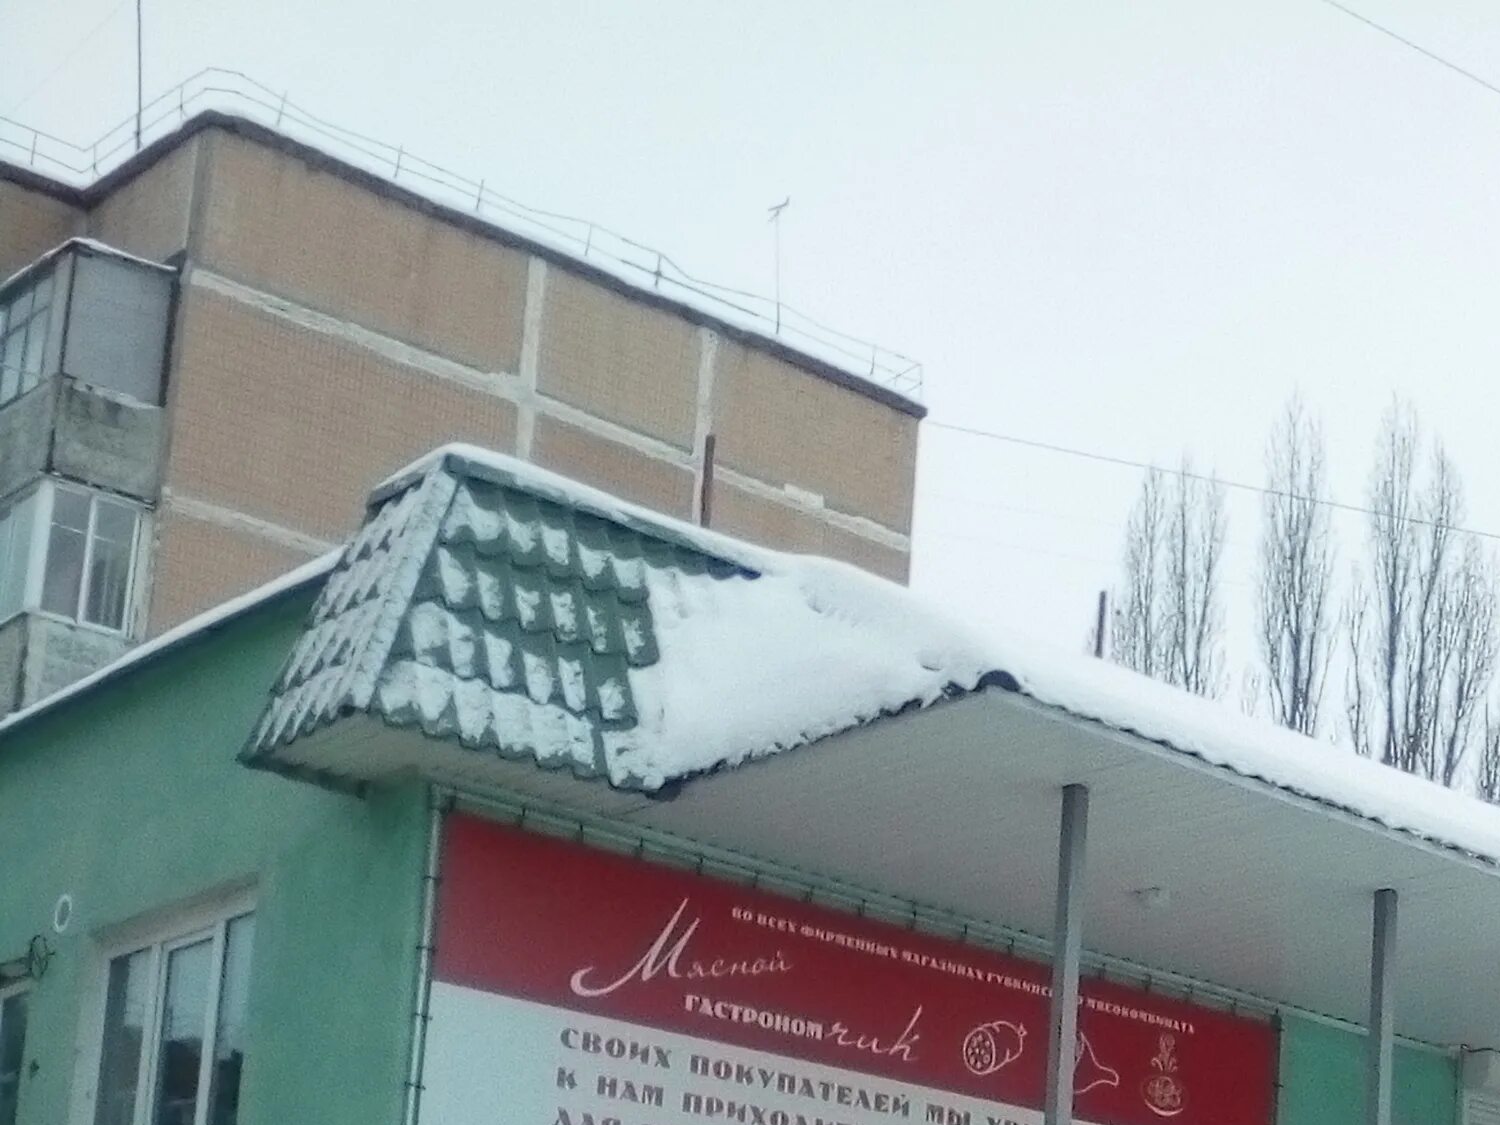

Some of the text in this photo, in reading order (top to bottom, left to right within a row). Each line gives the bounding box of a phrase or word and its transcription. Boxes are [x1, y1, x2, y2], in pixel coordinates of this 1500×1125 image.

[570, 898, 792, 997] Мясной
[556, 1066, 578, 1090] К
[597, 1075, 664, 1107] НАМ
[560, 1027, 672, 1069] СВОИХ
[690, 1054, 910, 1116] ПОКУПАТЕЛЕЙ
